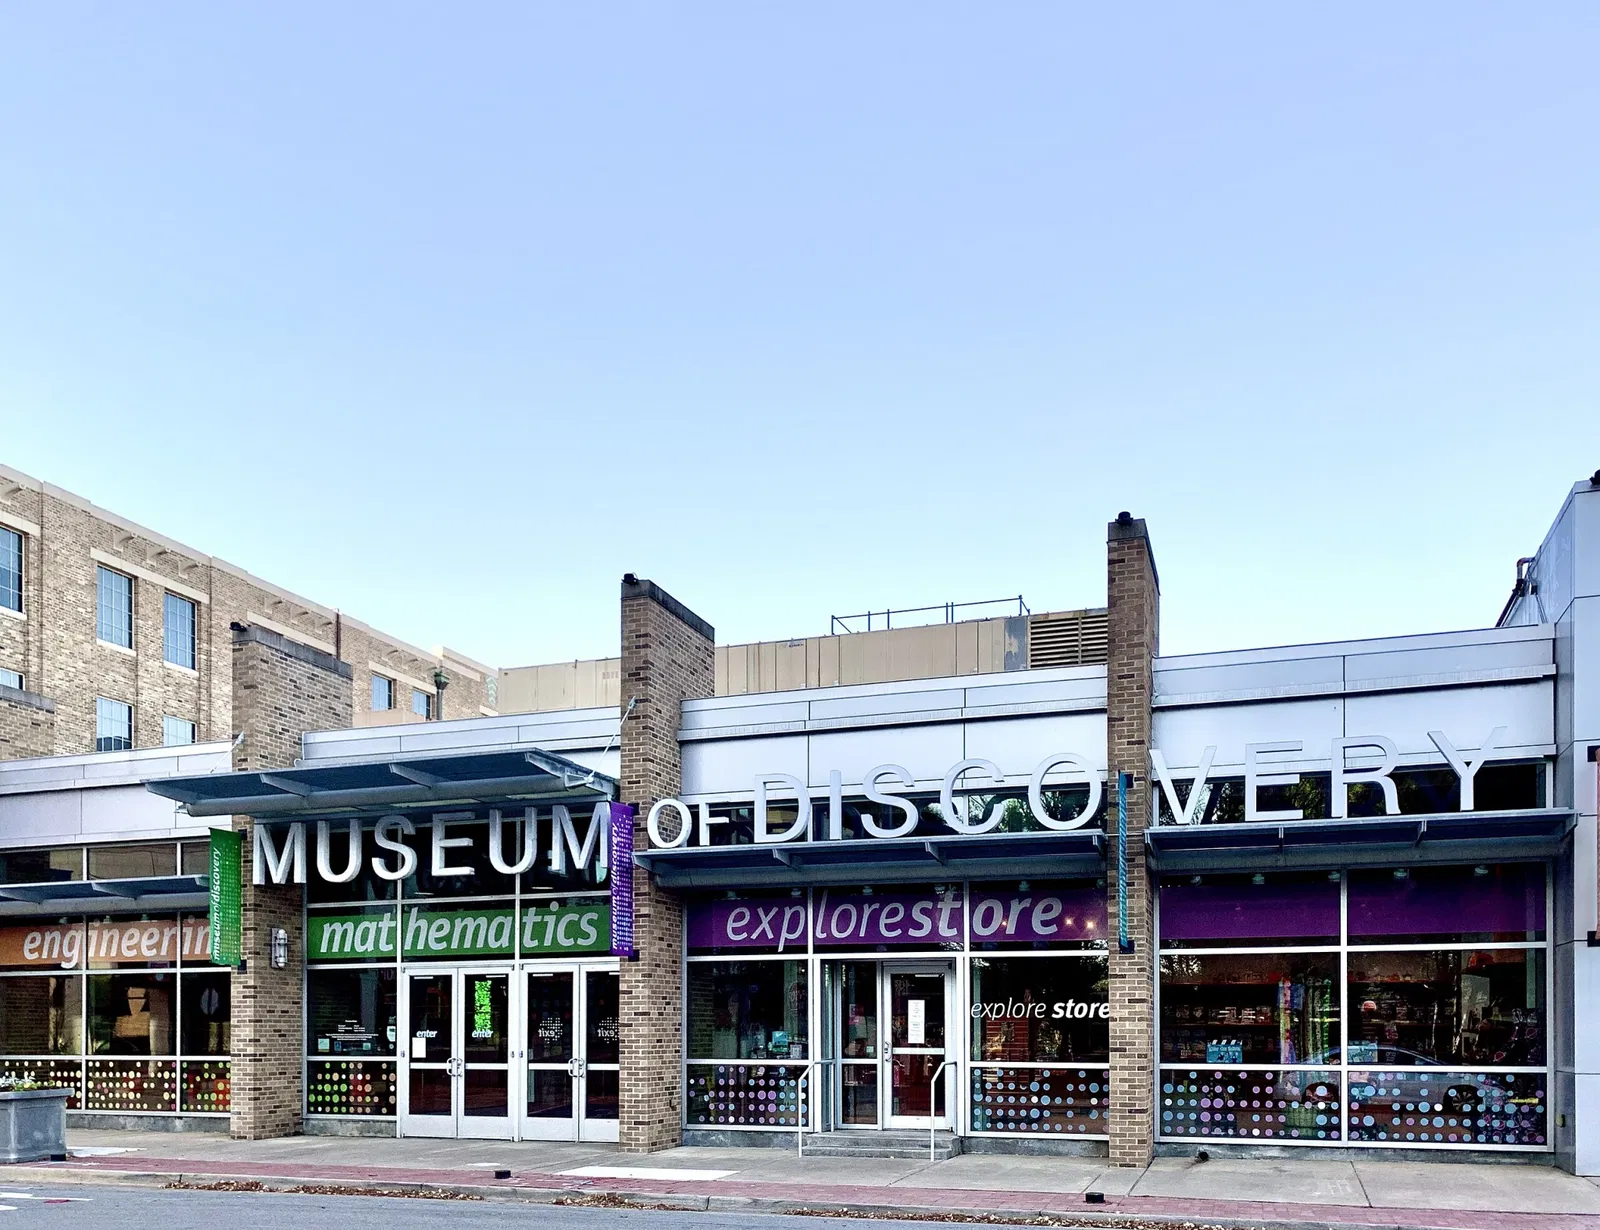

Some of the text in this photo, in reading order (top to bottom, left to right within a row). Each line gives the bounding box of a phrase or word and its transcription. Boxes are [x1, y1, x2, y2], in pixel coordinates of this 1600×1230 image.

[252, 802, 611, 885] MUSEUM
[646, 797, 730, 849] OF
[23, 915, 212, 969] engineerin
[319, 901, 599, 954] mathematics
[416, 1029, 437, 1039] enter
[970, 997, 1110, 1020] explore store
